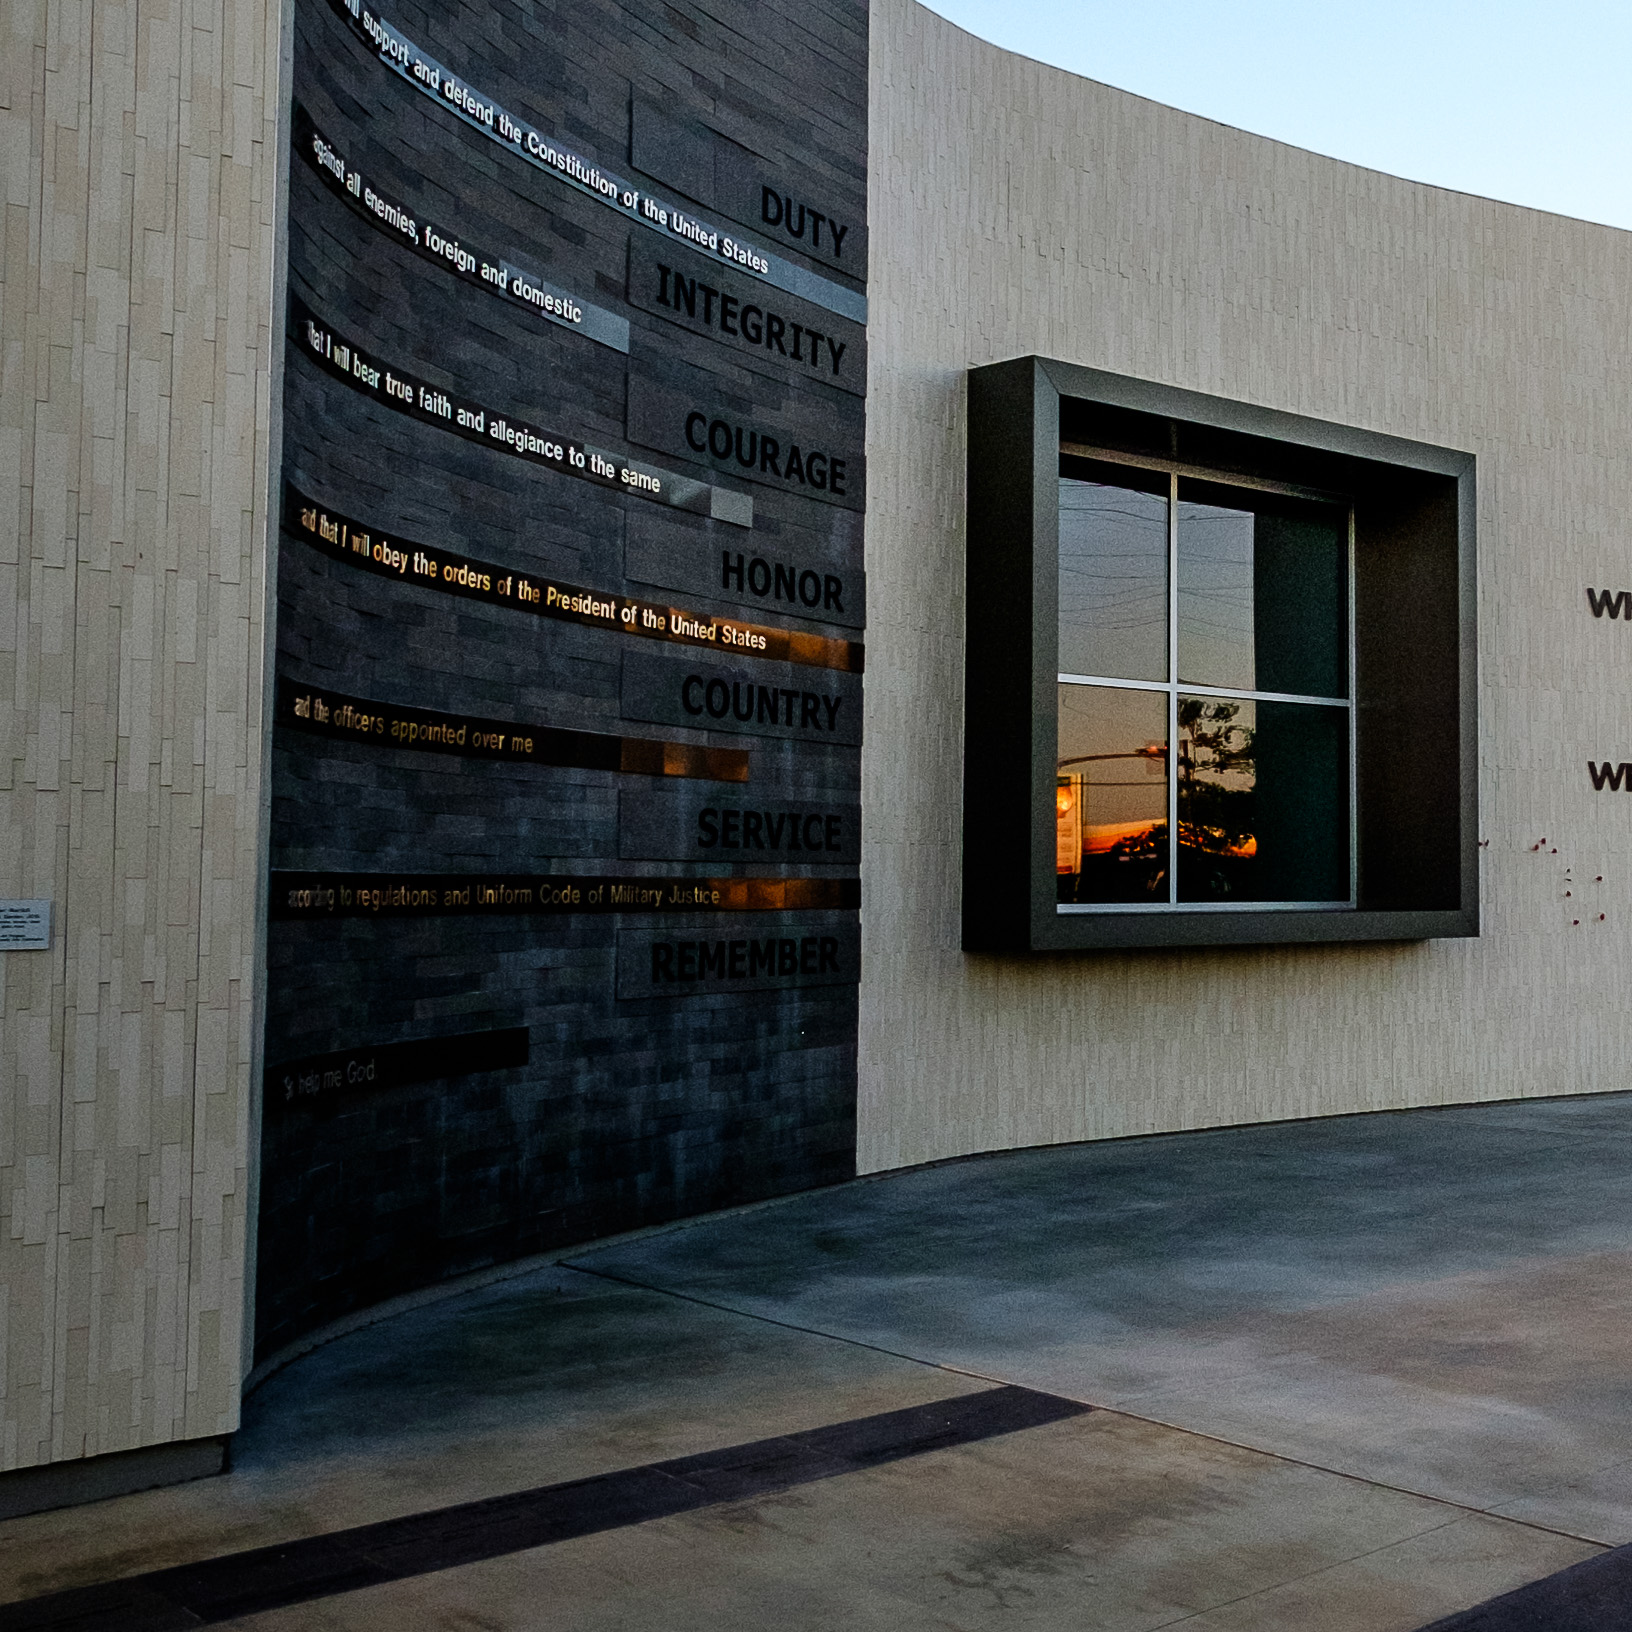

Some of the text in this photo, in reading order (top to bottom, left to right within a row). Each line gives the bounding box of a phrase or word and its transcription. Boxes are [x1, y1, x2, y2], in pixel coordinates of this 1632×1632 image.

[363, 11, 409, 66] support
[413, 59, 439, 90] and
[444, 79, 494, 126] defend
[499, 113, 521, 144] the
[527, 132, 618, 199] Constitution
[623, 191, 640, 210] of
[643, 198, 667, 225] the
[672, 211, 717, 250] United
[722, 238, 769, 274] States
[346, 172, 361, 198] all
[364, 187, 420, 245] enemies,
[425, 226, 475, 272] foreign
[481, 262, 507, 289] and
[513, 277, 582, 323] domestic
[761, 184, 848, 258] DUTY
[656, 264, 847, 376] INTEGRITY
[333, 345, 350, 371] will
[353, 353, 380, 389] bear
[385, 372, 413, 404] true
[419, 387, 452, 419] faith
[457, 408, 484, 432] and
[489, 419, 563, 461] allegiance
[569, 446, 586, 468] to
[590, 453, 615, 480] the
[621, 468, 661, 493] same
[685, 411, 846, 496] COURAGE
[341, 525, 347, 547] I
[351, 532, 370, 556] will
[373, 541, 408, 574] obey
[413, 552, 437, 578] the
[443, 565, 491, 591] orders
[497, 576, 512, 596] of
[518, 579, 540, 604] the
[546, 586, 616, 619] President
[621, 606, 637, 624] of
[642, 608, 666, 630] the
[671, 615, 717, 642] United
[721, 625, 767, 650] States
[722, 549, 845, 613] HONOR
[333, 704, 385, 734] officers
[391, 720, 467, 746] appointed
[472, 731, 506, 750] over
[511, 735, 534, 753] me
[681, 674, 842, 731] COUNTRY
[697, 808, 843, 852] SERVICE
[356, 884, 438, 911] regulations
[443, 884, 470, 906] and
[476, 883, 533, 905] Uniform
[540, 883, 581, 905] Code
[588, 884, 604, 905] of
[611, 884, 663, 907] Military
[669, 885, 721, 905] Justice
[651, 936, 841, 984] REMEMBER
[323, 1070, 343, 1088] me
